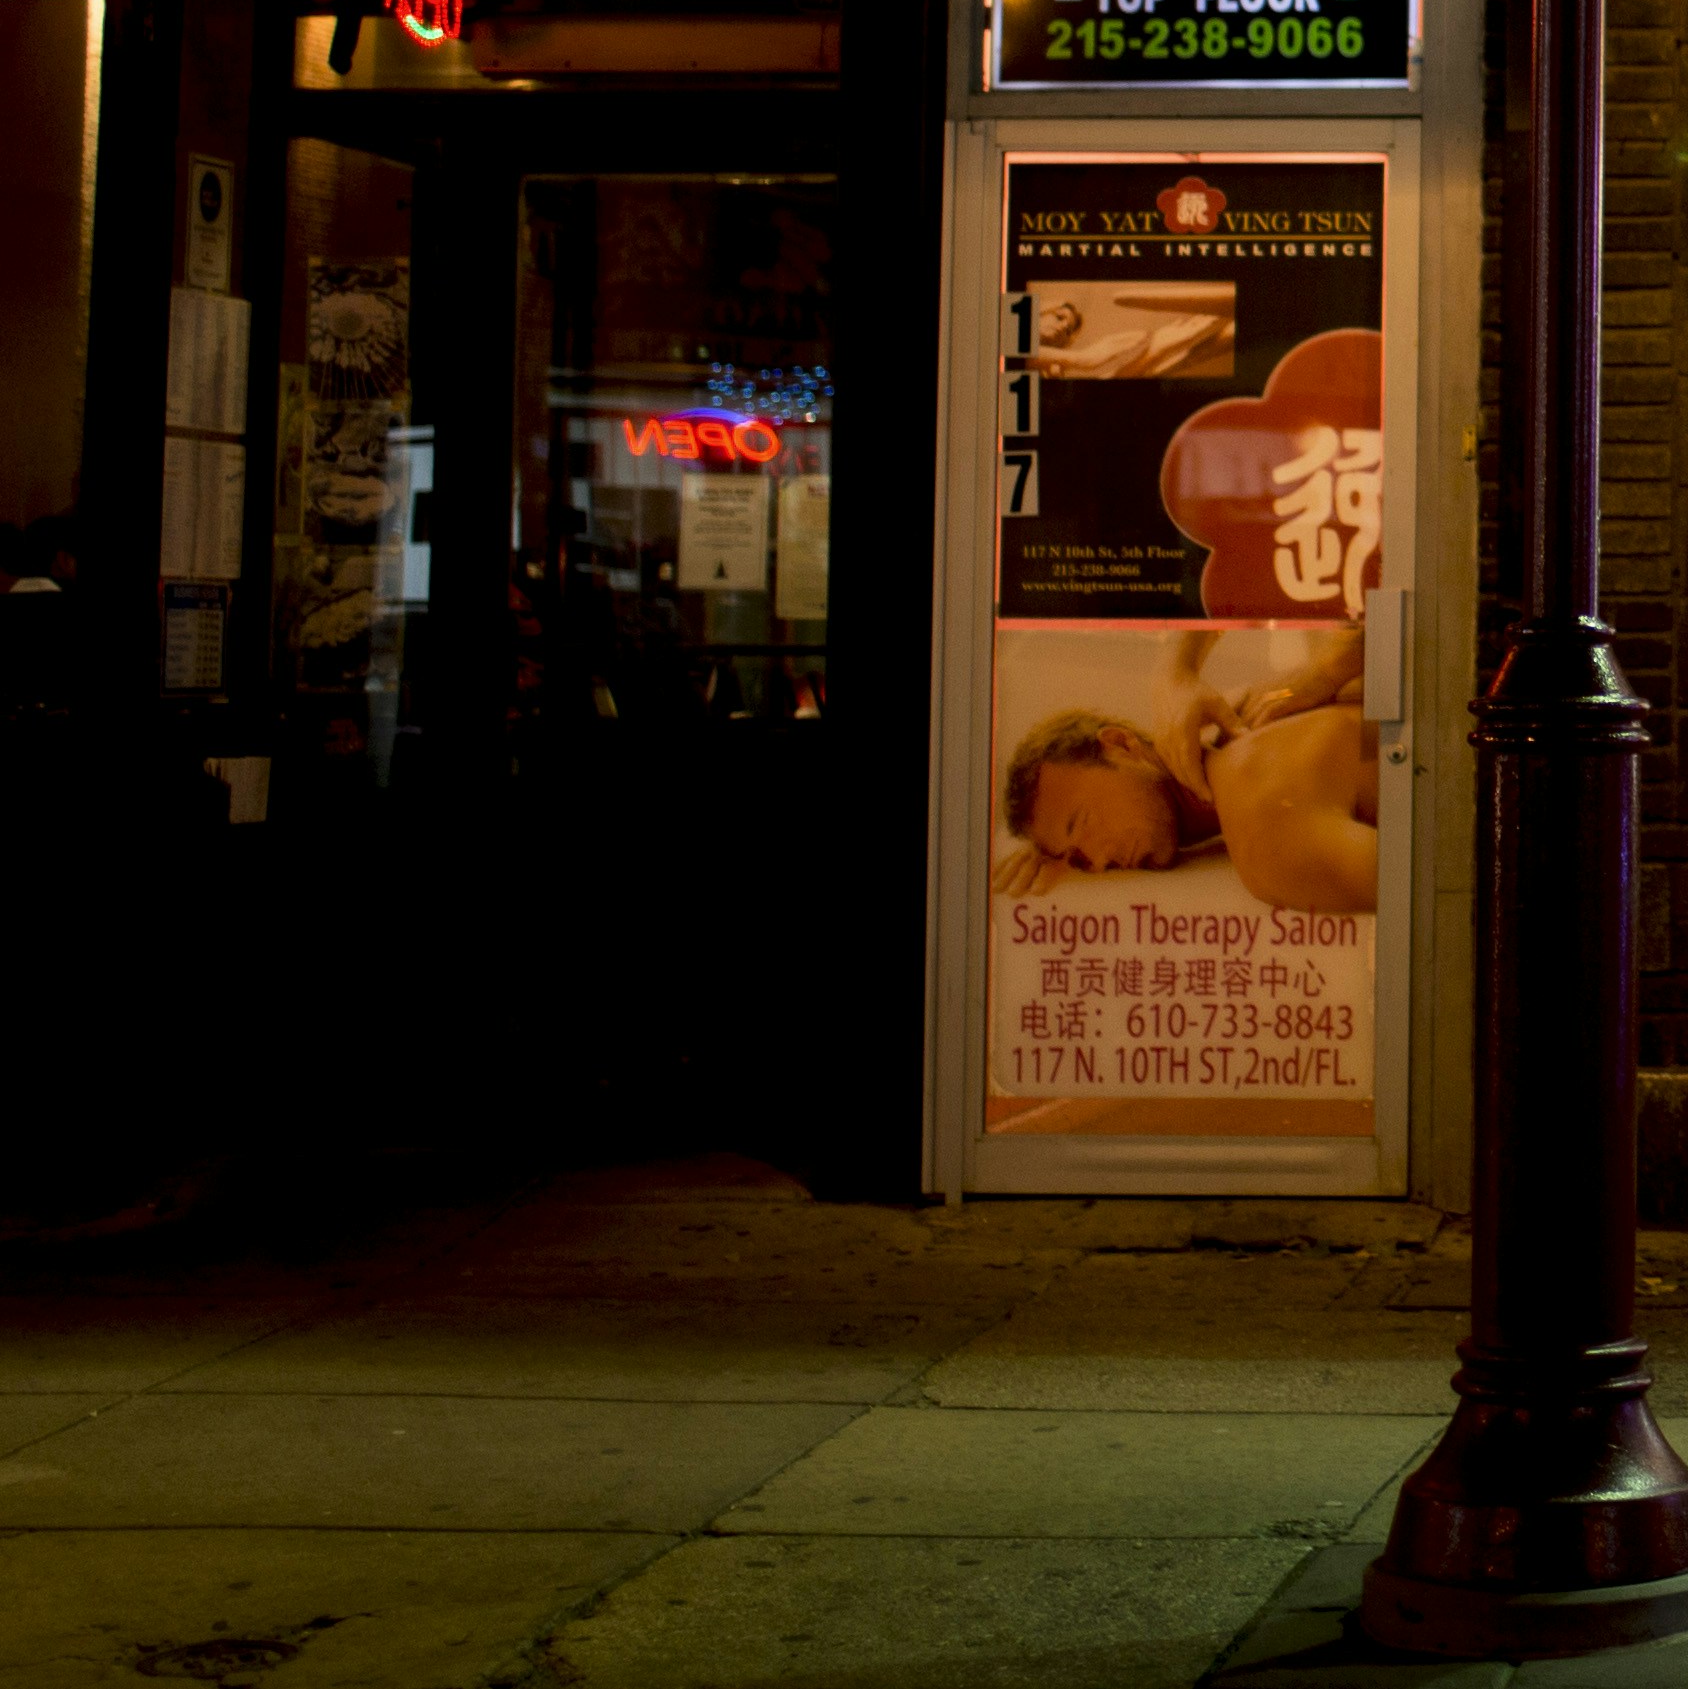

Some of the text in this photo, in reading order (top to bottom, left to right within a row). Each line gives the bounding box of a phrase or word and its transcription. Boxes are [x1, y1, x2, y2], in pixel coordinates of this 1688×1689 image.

[1046, 18, 1364, 59] 215-238-9066
[1021, 213, 1372, 233] MOY YAT VING TSUN
[1019, 243, 1373, 258] MARTIAL INTELLIGENCE
[1023, 544, 1046, 559] 117
[1012, 904, 1120, 954] Saigon
[1270, 906, 1357, 946] Salon
[1040, 958, 1326, 999] 西贡健身理容中心
[1126, 1003, 1354, 1040] 610-733-8843
[1013, 1047, 1064, 1084] 117
[1074, 1047, 1104, 1084] N.
[1115, 1047, 1190, 1084] 10TH
